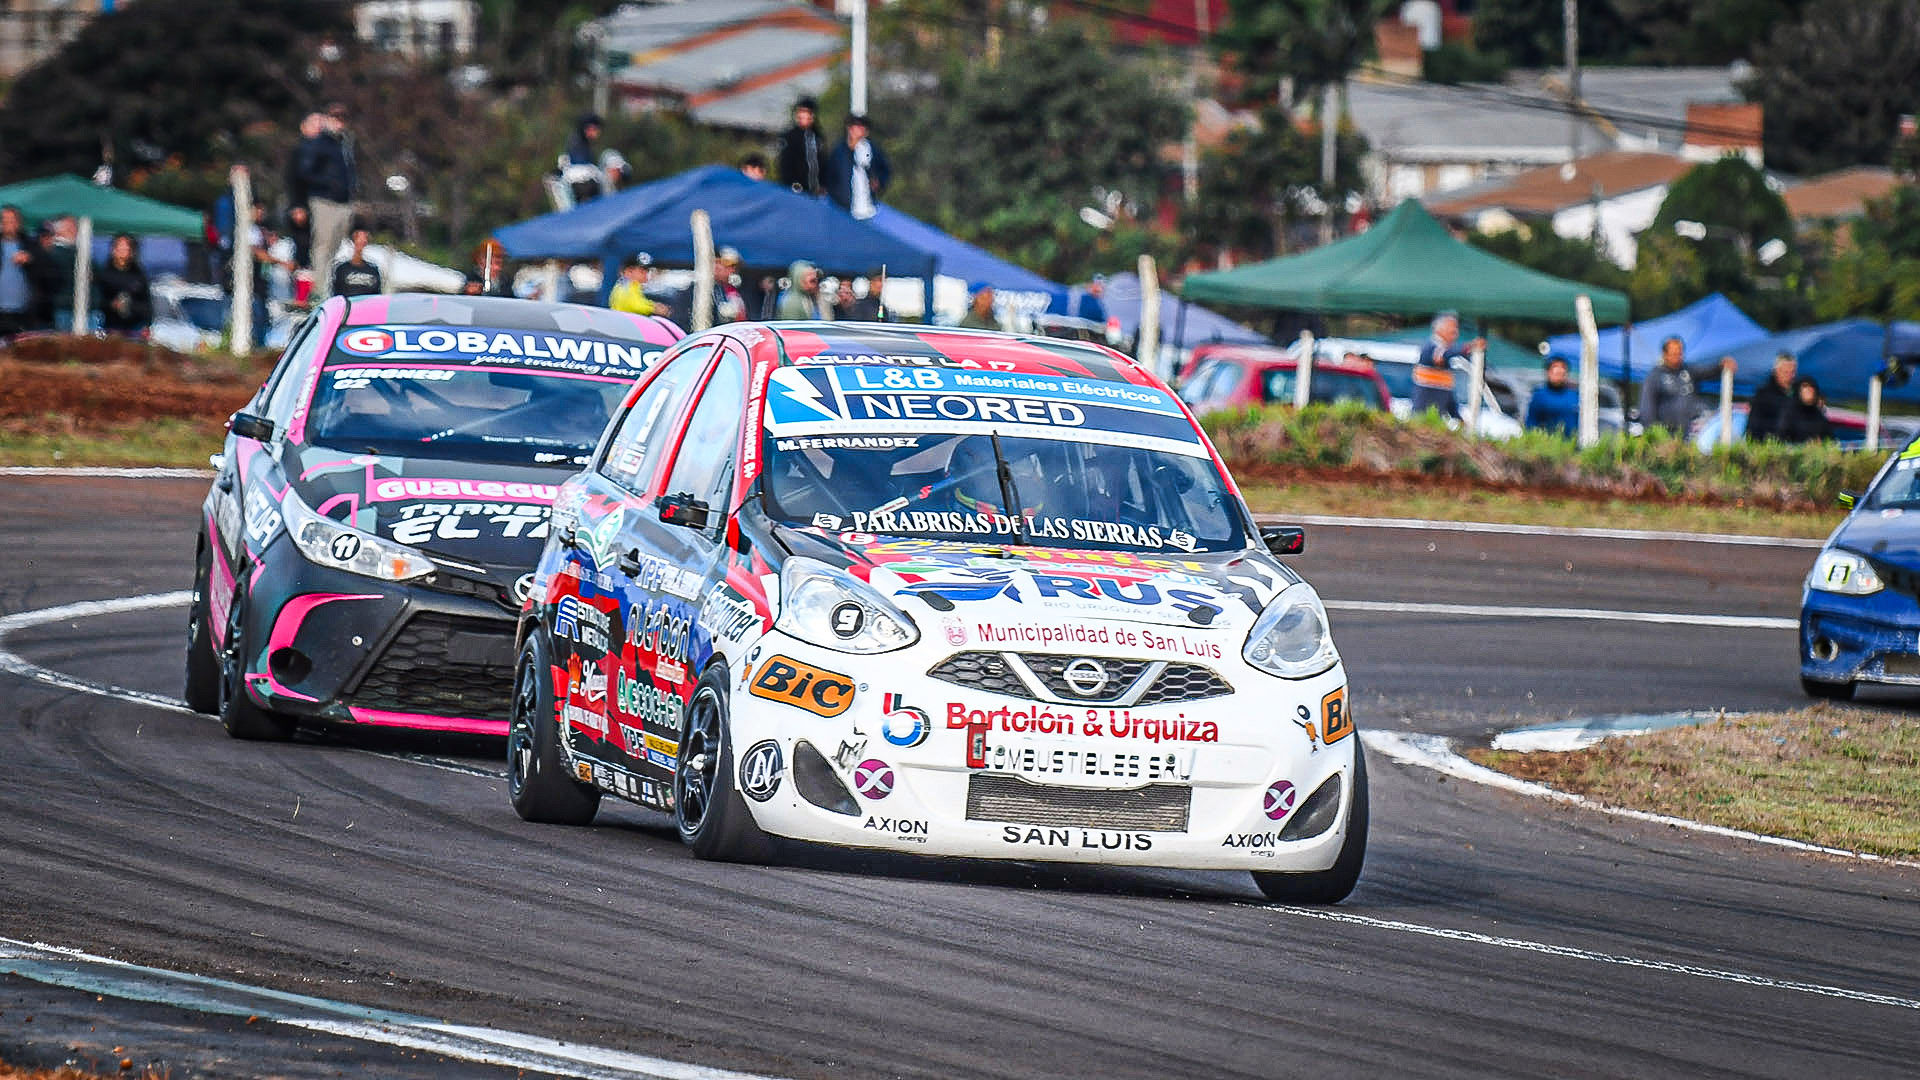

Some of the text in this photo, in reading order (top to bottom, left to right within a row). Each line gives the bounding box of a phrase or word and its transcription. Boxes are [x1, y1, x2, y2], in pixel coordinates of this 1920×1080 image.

[939, 357, 982, 368] LA
[854, 367, 1162, 405] L&B Materiales Eléctricos
[861, 394, 1086, 427] NEORED
[388, 515, 480, 545] EL
[850, 510, 1164, 550] PARABRISAS DE LAS SIERRAS
[334, 535, 358, 558] 11
[1031, 574, 1225, 616] RUS
[834, 608, 861, 631] 9
[977, 622, 1222, 660] Municipalidad de San Luis
[946, 702, 1219, 744] Bortolón & Urquiza
[863, 815, 929, 835] AXION
[897, 834, 928, 844] energy
[1002, 825, 1153, 852] SAN LUIS
[1220, 831, 1276, 848] AXION
